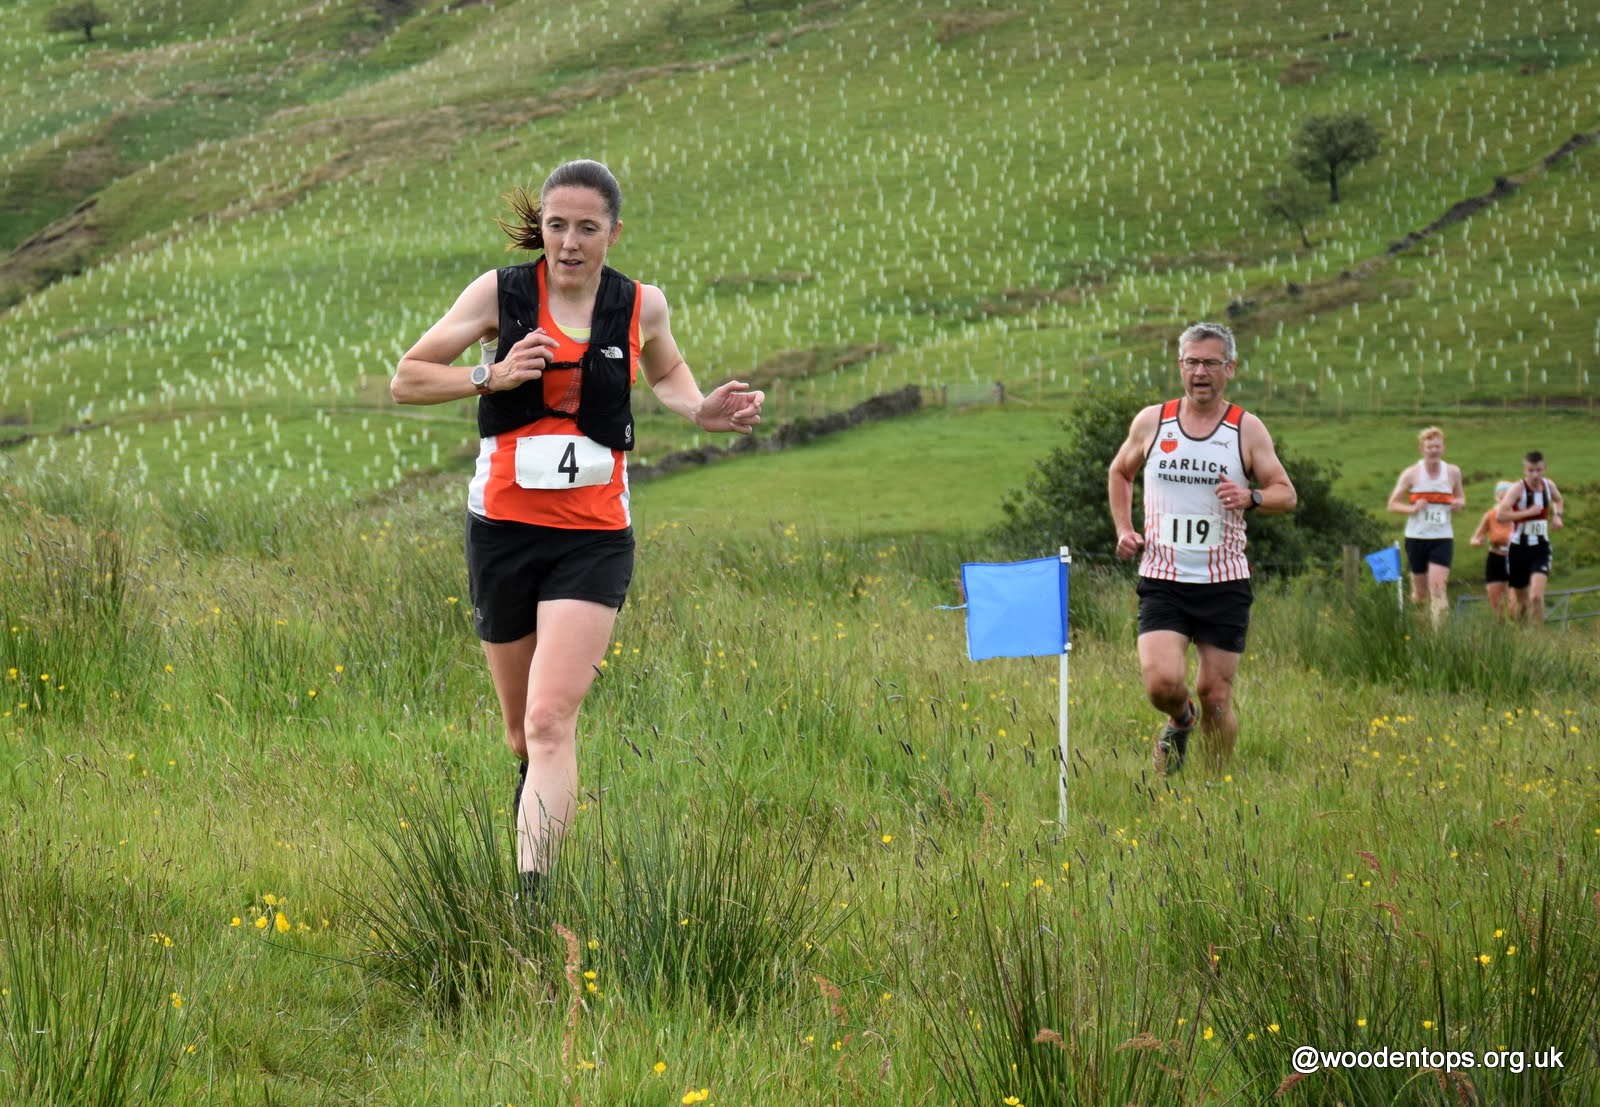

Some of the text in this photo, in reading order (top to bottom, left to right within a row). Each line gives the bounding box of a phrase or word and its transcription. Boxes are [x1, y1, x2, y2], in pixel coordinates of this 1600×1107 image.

[557, 441, 579, 483] 4
[1158, 458, 1229, 475] BARLICK
[1157, 472, 1222, 486] FELLRUNNER
[1172, 518, 1210, 544] 119
